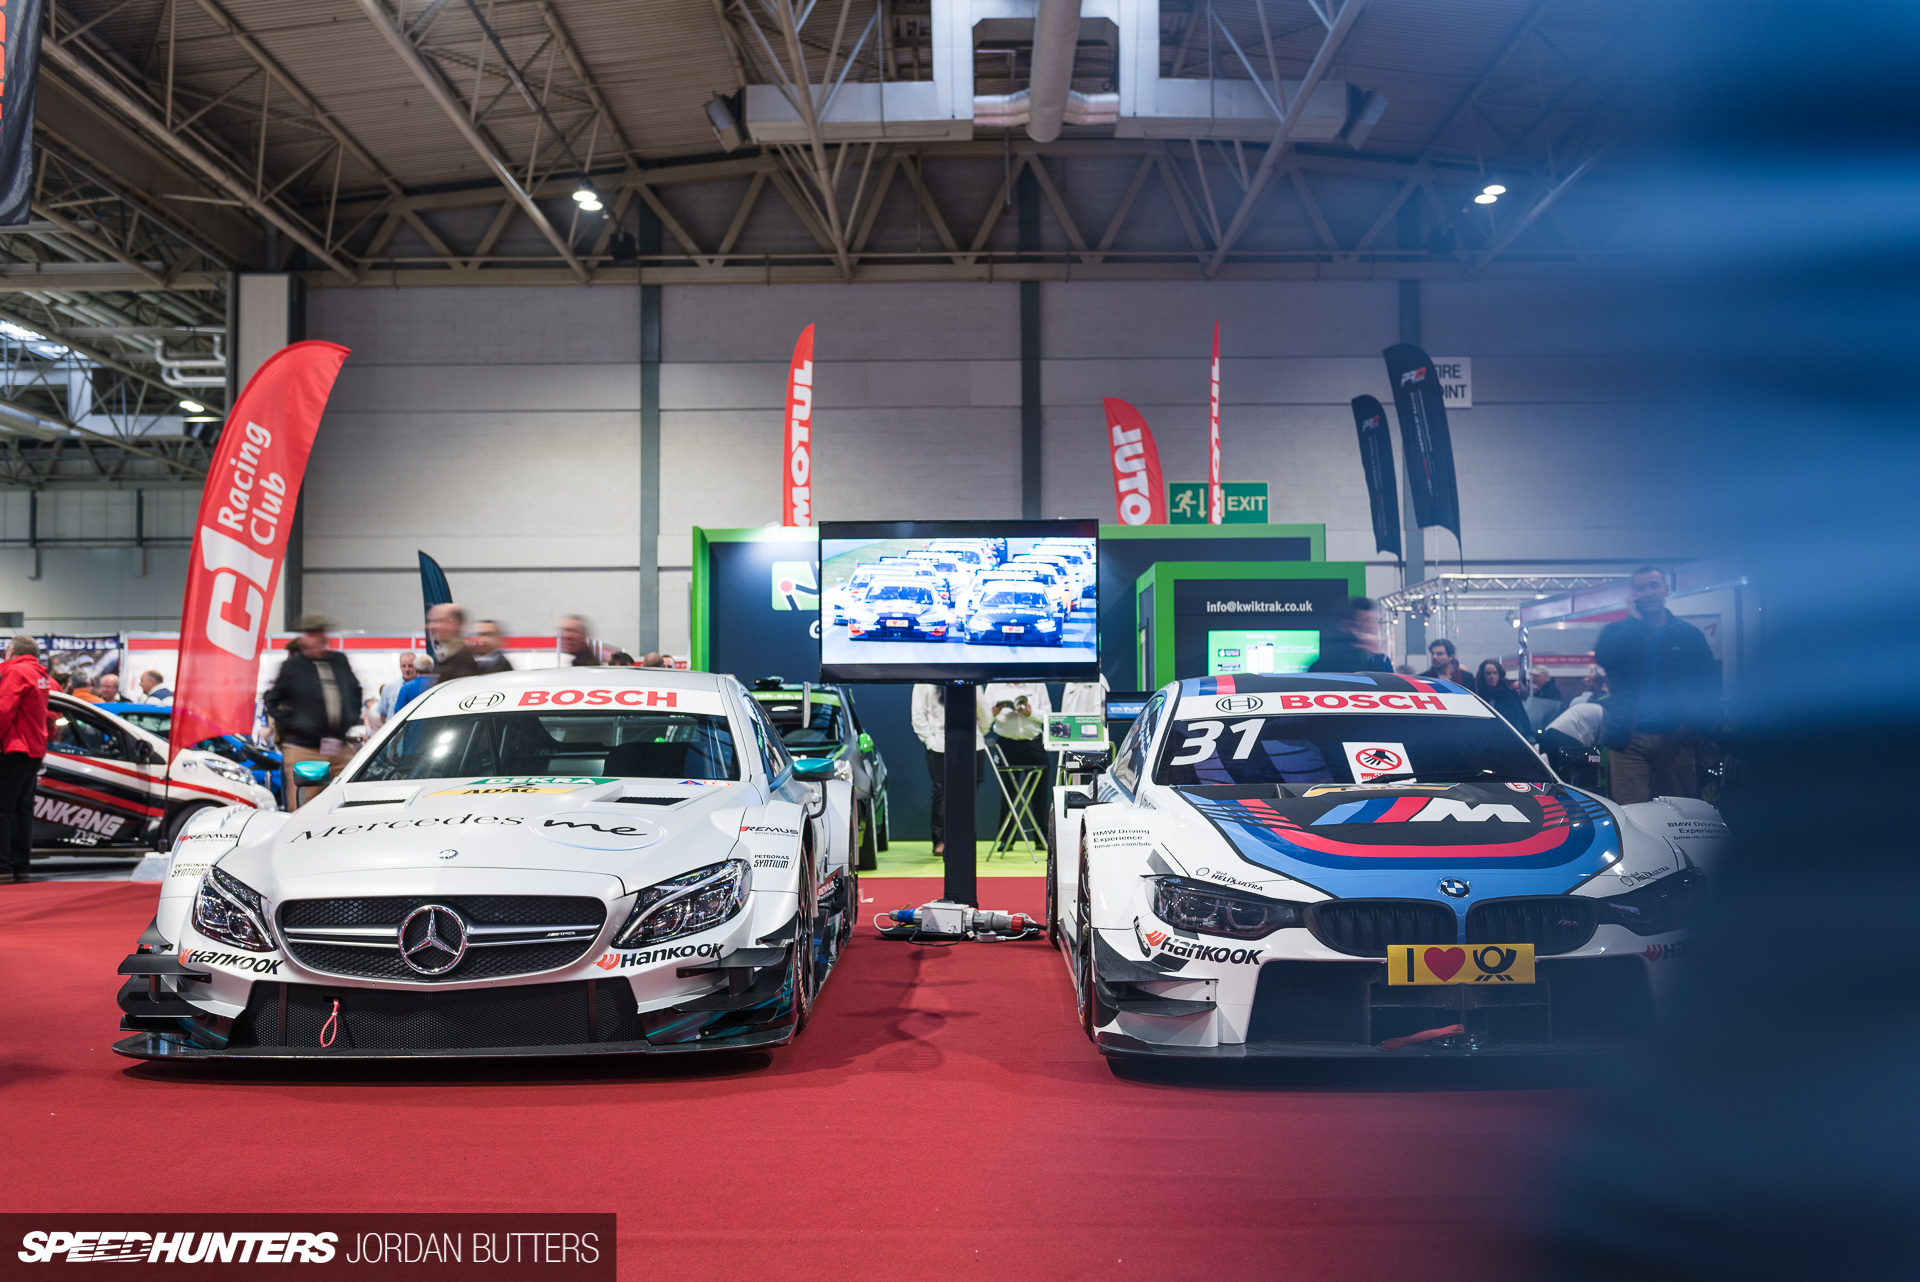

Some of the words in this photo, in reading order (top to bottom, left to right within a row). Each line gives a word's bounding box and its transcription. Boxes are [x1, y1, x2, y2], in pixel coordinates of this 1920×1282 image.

[791, 360, 813, 527] MOTUL
[217, 421, 272, 532] Racing
[250, 472, 286, 545] Club
[1227, 496, 1266, 512] EXIT
[200, 525, 274, 660] C1
[1206, 600, 1313, 613] info@kwiktrak.co.uk
[518, 689, 678, 708] BOSCH
[1280, 694, 1448, 711] BOSCH
[1170, 718, 1266, 766] 31
[461, 787, 542, 795] ADAC
[33, 795, 126, 837] ANKANG
[285, 813, 525, 844] Mercedes
[543, 818, 648, 837] me
[745, 826, 799, 835] REMUS
[1092, 829, 1117, 837] BMW
[1093, 835, 1143, 843] Experience
[753, 859, 789, 869] SYNTIUM
[1211, 873, 1237, 885] HELIX
[1237, 880, 1263, 891] ULTRA
